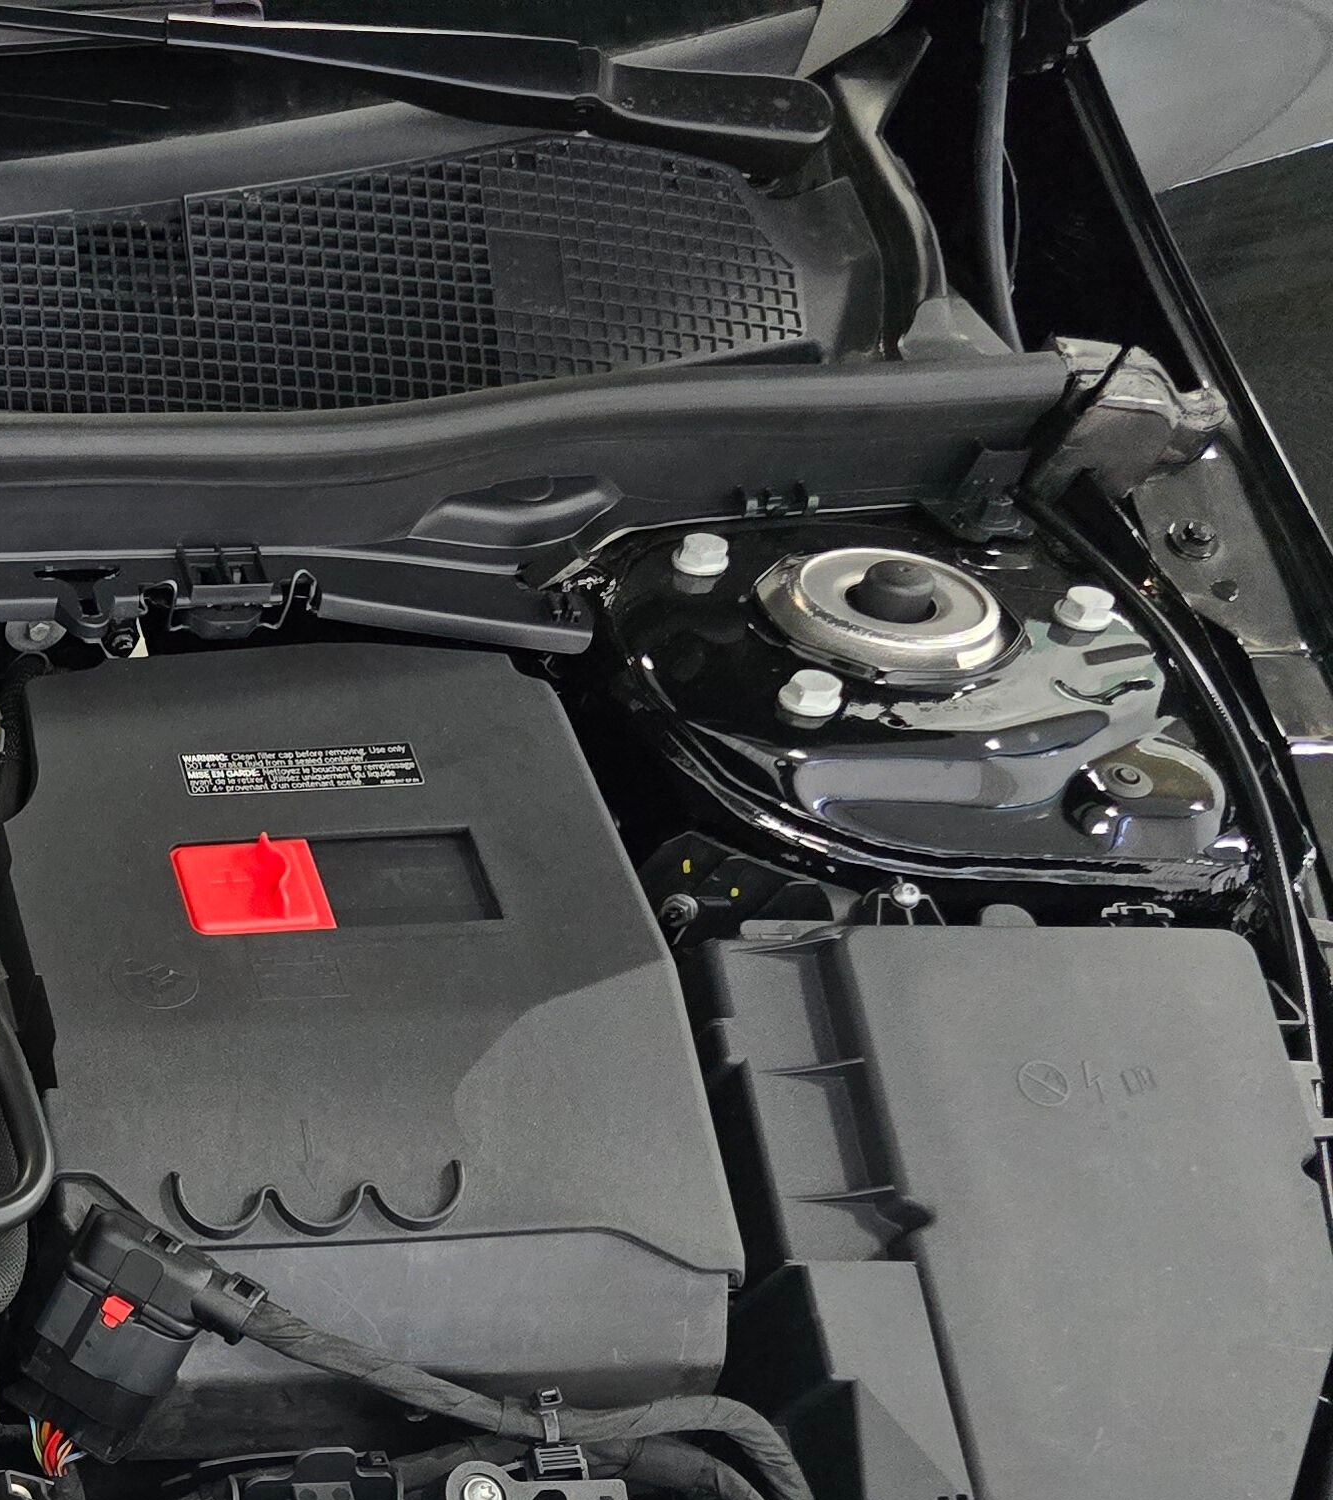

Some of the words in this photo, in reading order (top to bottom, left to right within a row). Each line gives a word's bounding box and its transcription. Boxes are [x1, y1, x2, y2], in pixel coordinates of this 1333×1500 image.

[182, 754, 229, 762] WARNING:
[231, 753, 256, 761] Clean
[278, 752, 294, 760] cap
[368, 746, 386, 755] Use
[387, 746, 406, 754] only
[187, 770, 211, 779] MISE
[211, 770, 225, 778] EN
